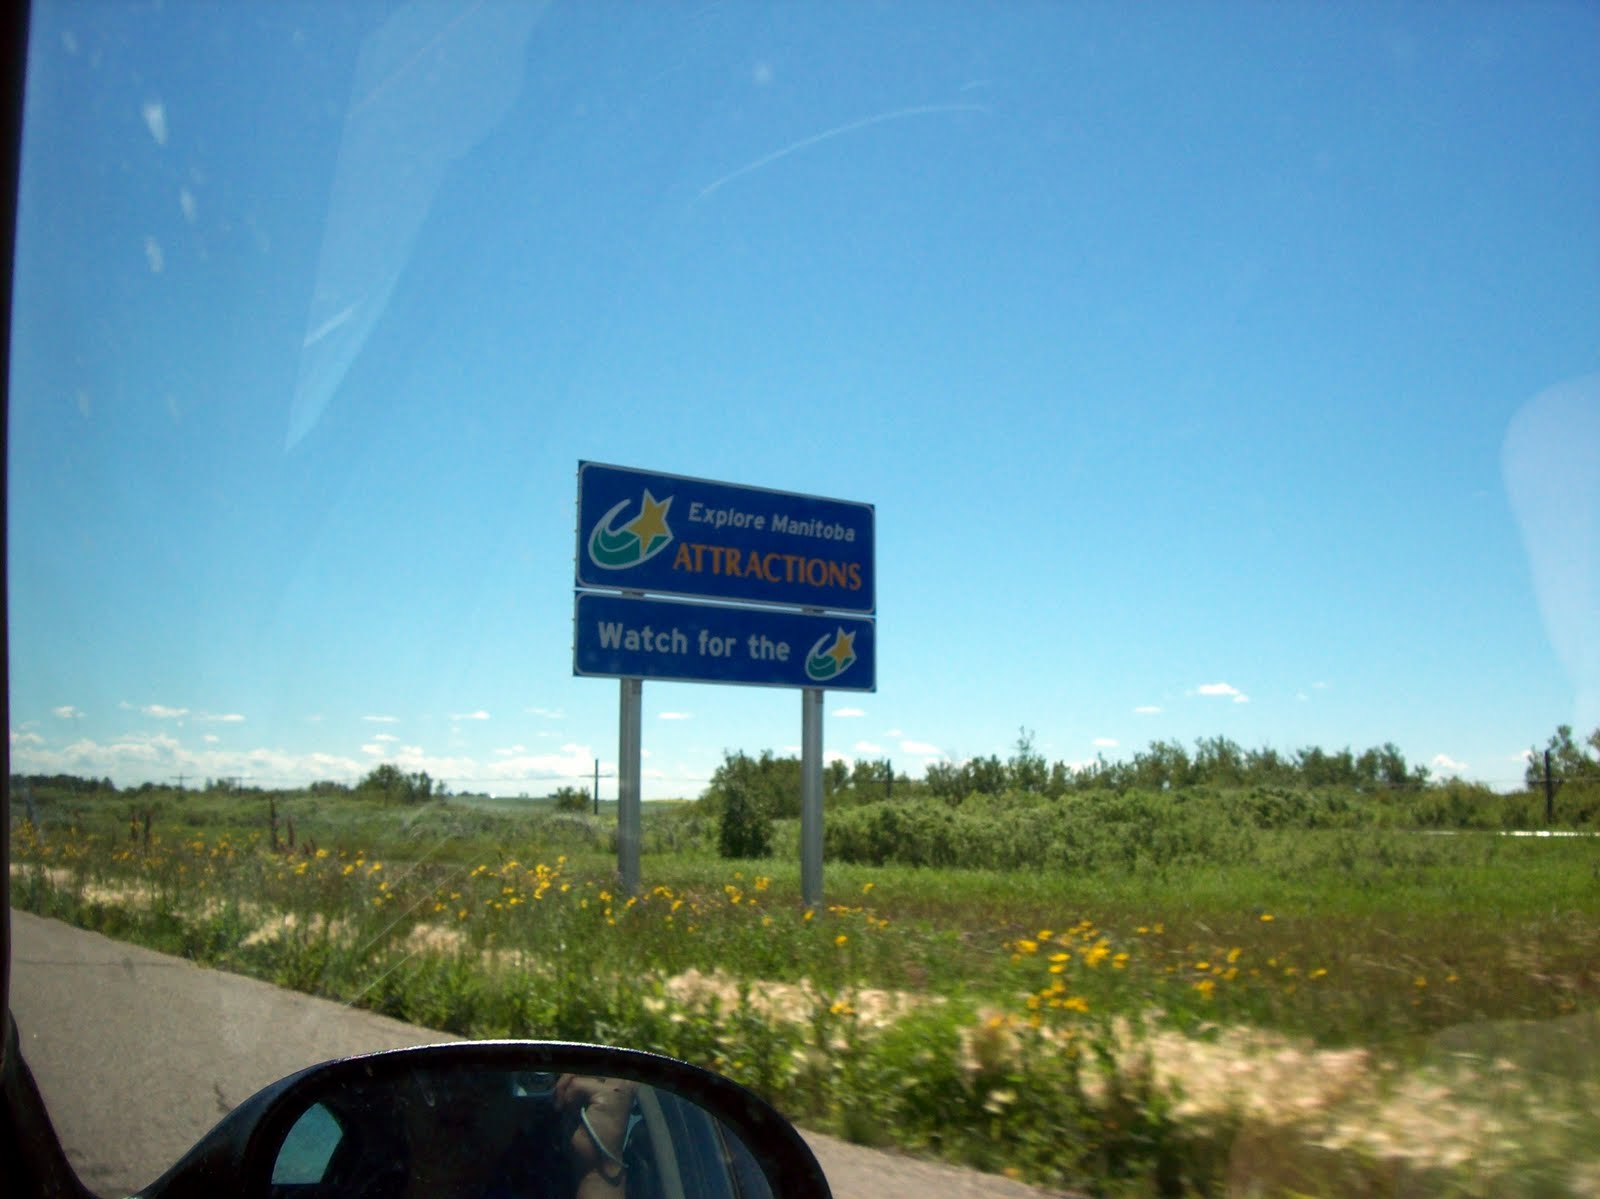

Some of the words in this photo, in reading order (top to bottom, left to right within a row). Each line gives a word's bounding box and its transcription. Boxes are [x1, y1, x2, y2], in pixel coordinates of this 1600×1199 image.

[688, 502, 766, 530] Explore
[771, 513, 856, 542] Manitoba
[672, 542, 863, 590] ATTRACTIONS
[598, 621, 688, 655] Watch
[698, 629, 737, 657] for
[748, 635, 791, 662] the
